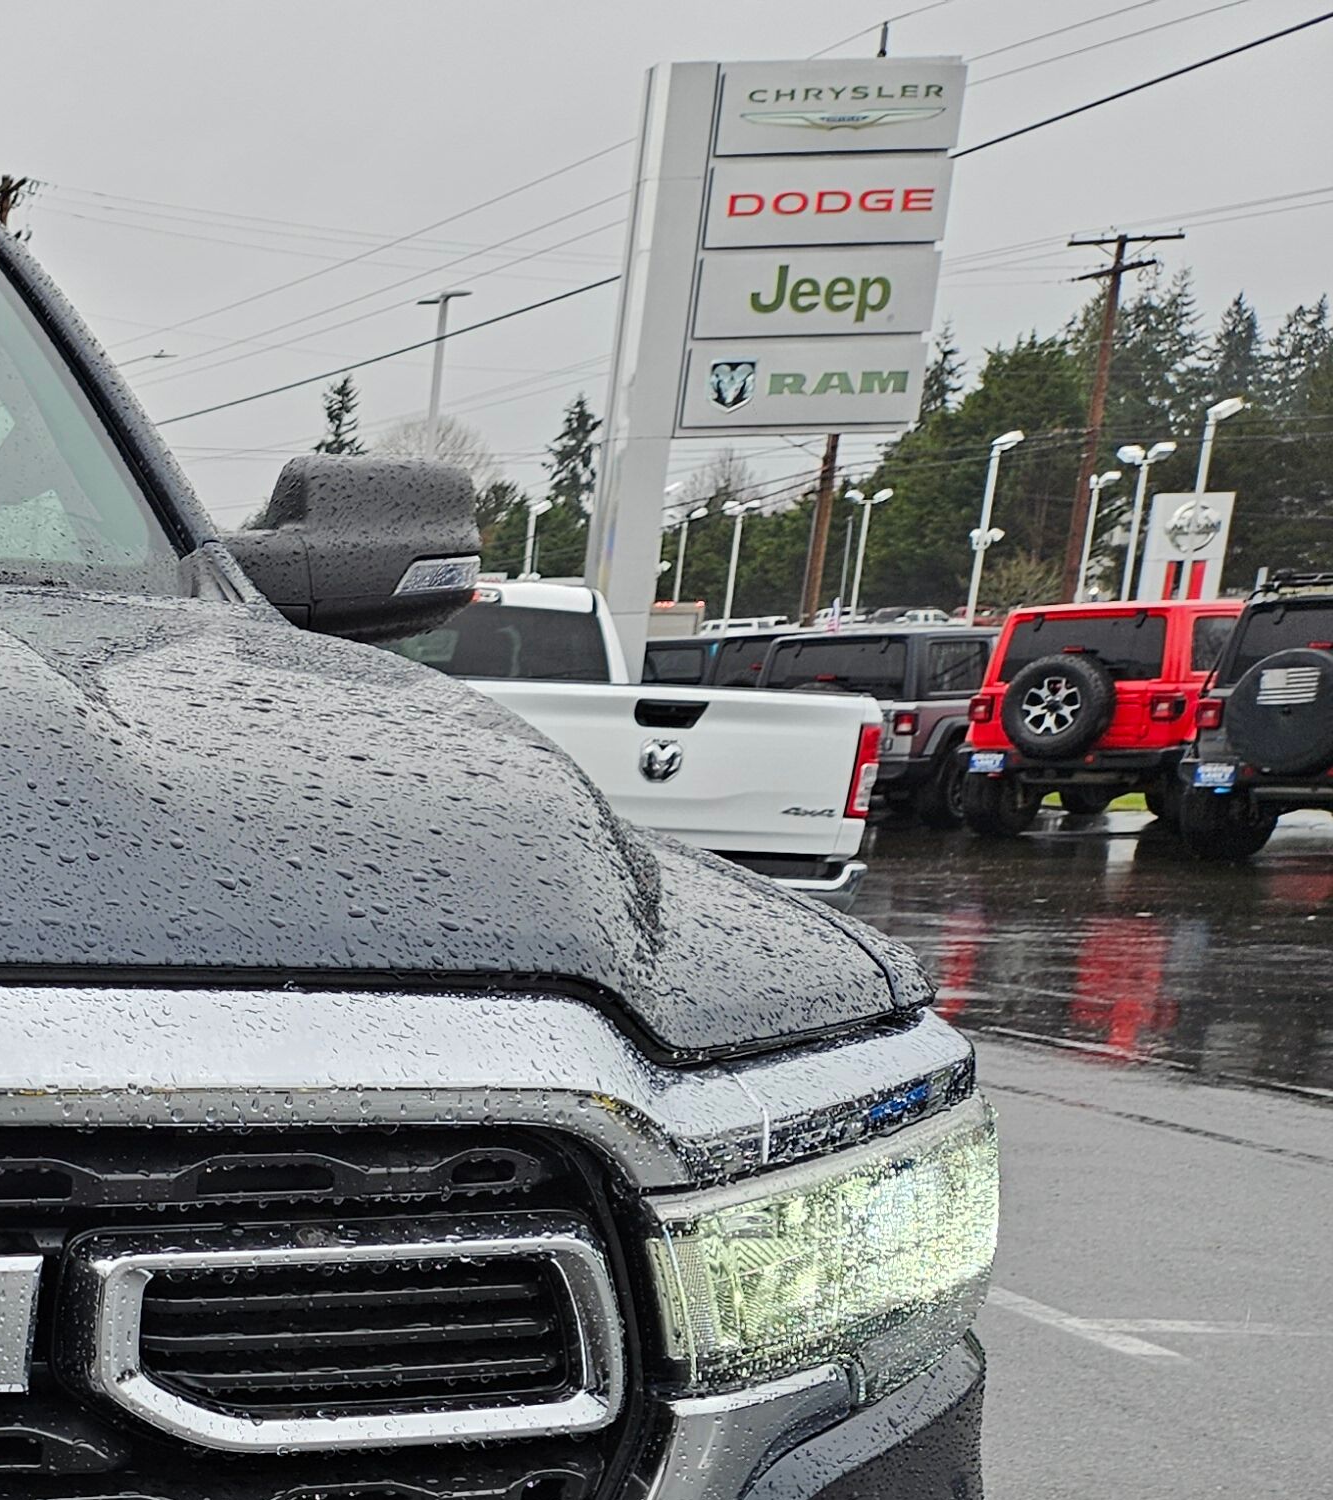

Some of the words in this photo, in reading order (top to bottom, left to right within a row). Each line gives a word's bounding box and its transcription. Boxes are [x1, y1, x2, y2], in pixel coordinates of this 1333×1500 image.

[748, 84, 944, 103] CHRYSLER
[727, 188, 935, 218] DODGE
[749, 264, 892, 323] Jeep
[767, 370, 910, 396] RAM
